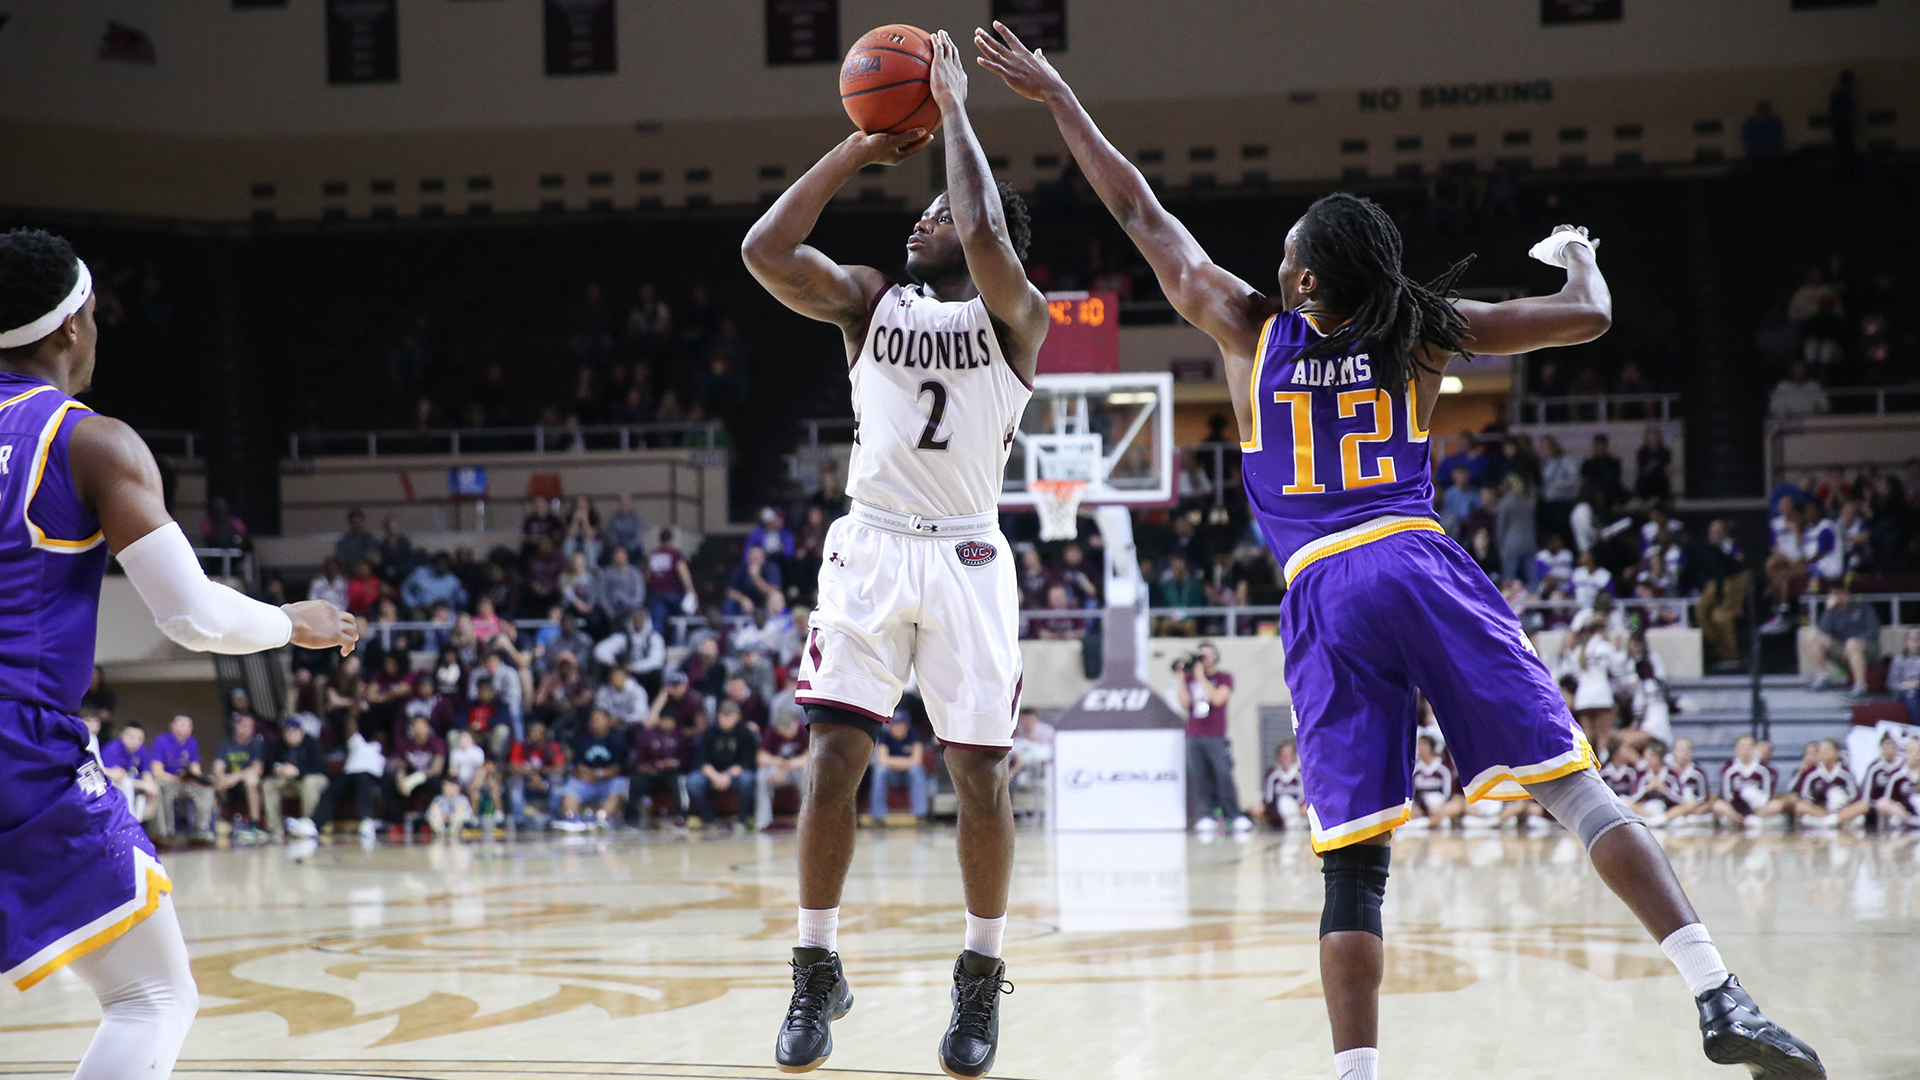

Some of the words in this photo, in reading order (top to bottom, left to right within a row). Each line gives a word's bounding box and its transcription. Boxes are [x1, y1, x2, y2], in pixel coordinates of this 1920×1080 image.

[1357, 89, 1400, 111] NO
[1418, 78, 1553, 109] SMOKING
[873, 325, 991, 370] COLONELS
[1291, 353, 1373, 387] ADAMS
[915, 378, 953, 452] 2
[1273, 388, 1397, 495] 12
[1083, 688, 1151, 712] EKU
[1096, 770, 1179, 782] LEXUS
